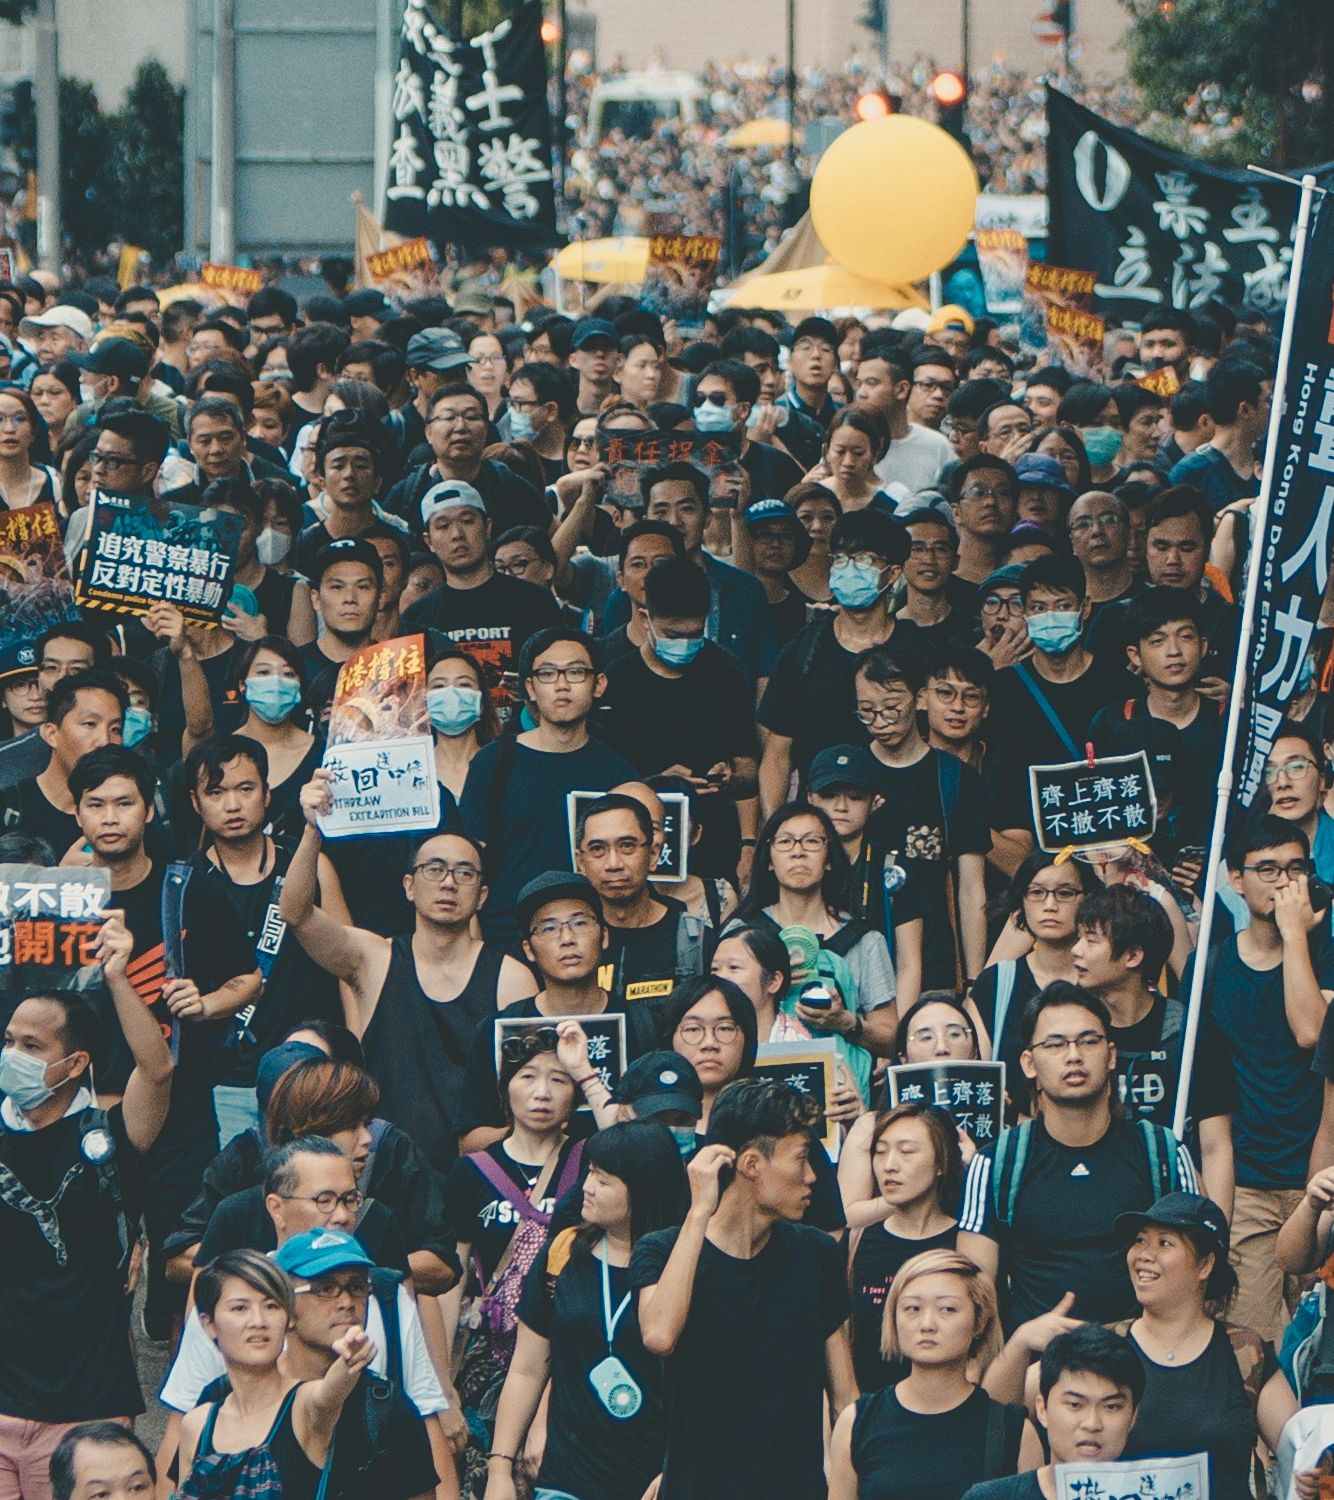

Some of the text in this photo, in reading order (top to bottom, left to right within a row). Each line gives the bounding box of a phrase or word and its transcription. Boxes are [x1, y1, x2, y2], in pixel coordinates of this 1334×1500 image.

[97, 531, 231, 581] 追究警察暴行
[90, 560, 224, 609] 反對定性暴動
[444, 626, 512, 642] UPPORT
[334, 795, 381, 811] ITHDRAW
[1040, 773, 1143, 810] 齊上齊落
[412, 804, 431, 818] BILL
[1046, 802, 1148, 837] 不撤不散
